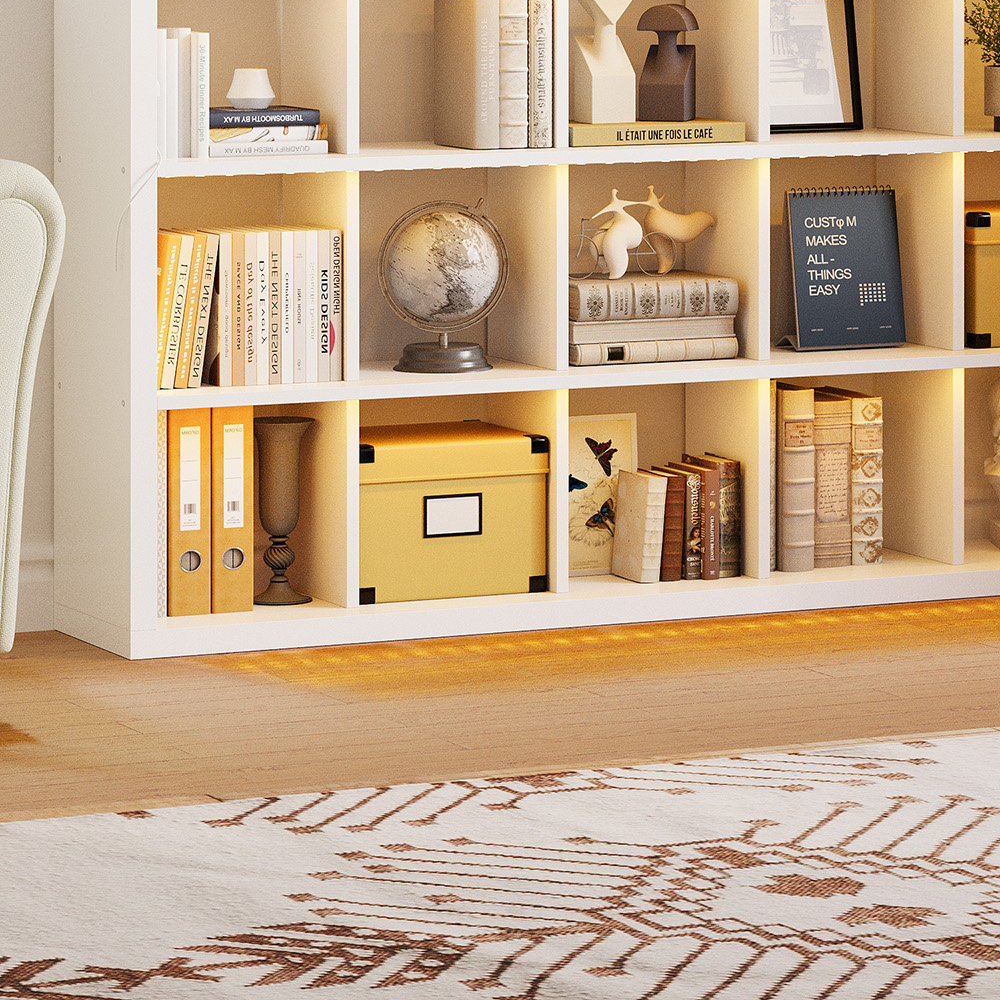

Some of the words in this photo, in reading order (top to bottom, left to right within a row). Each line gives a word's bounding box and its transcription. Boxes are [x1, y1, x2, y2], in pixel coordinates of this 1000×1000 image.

[480, 17, 488, 50] HOUSE
[242, 115, 251, 123] BY
[252, 114, 304, 122] TURBOSMOOTH
[198, 111, 206, 142] Recipes
[616, 130, 624, 141] IL
[625, 128, 647, 141] ÉTAIT
[648, 129, 664, 141] UNE
[665, 129, 682, 140] FOIS
[683, 128, 693, 140] LE
[694, 126, 713, 139] CAFÉ
[805, 234, 848, 247] MAKES
[807, 253, 829, 265] ALL
[807, 268, 853, 281] THINGS
[809, 283, 841, 297] EASY
